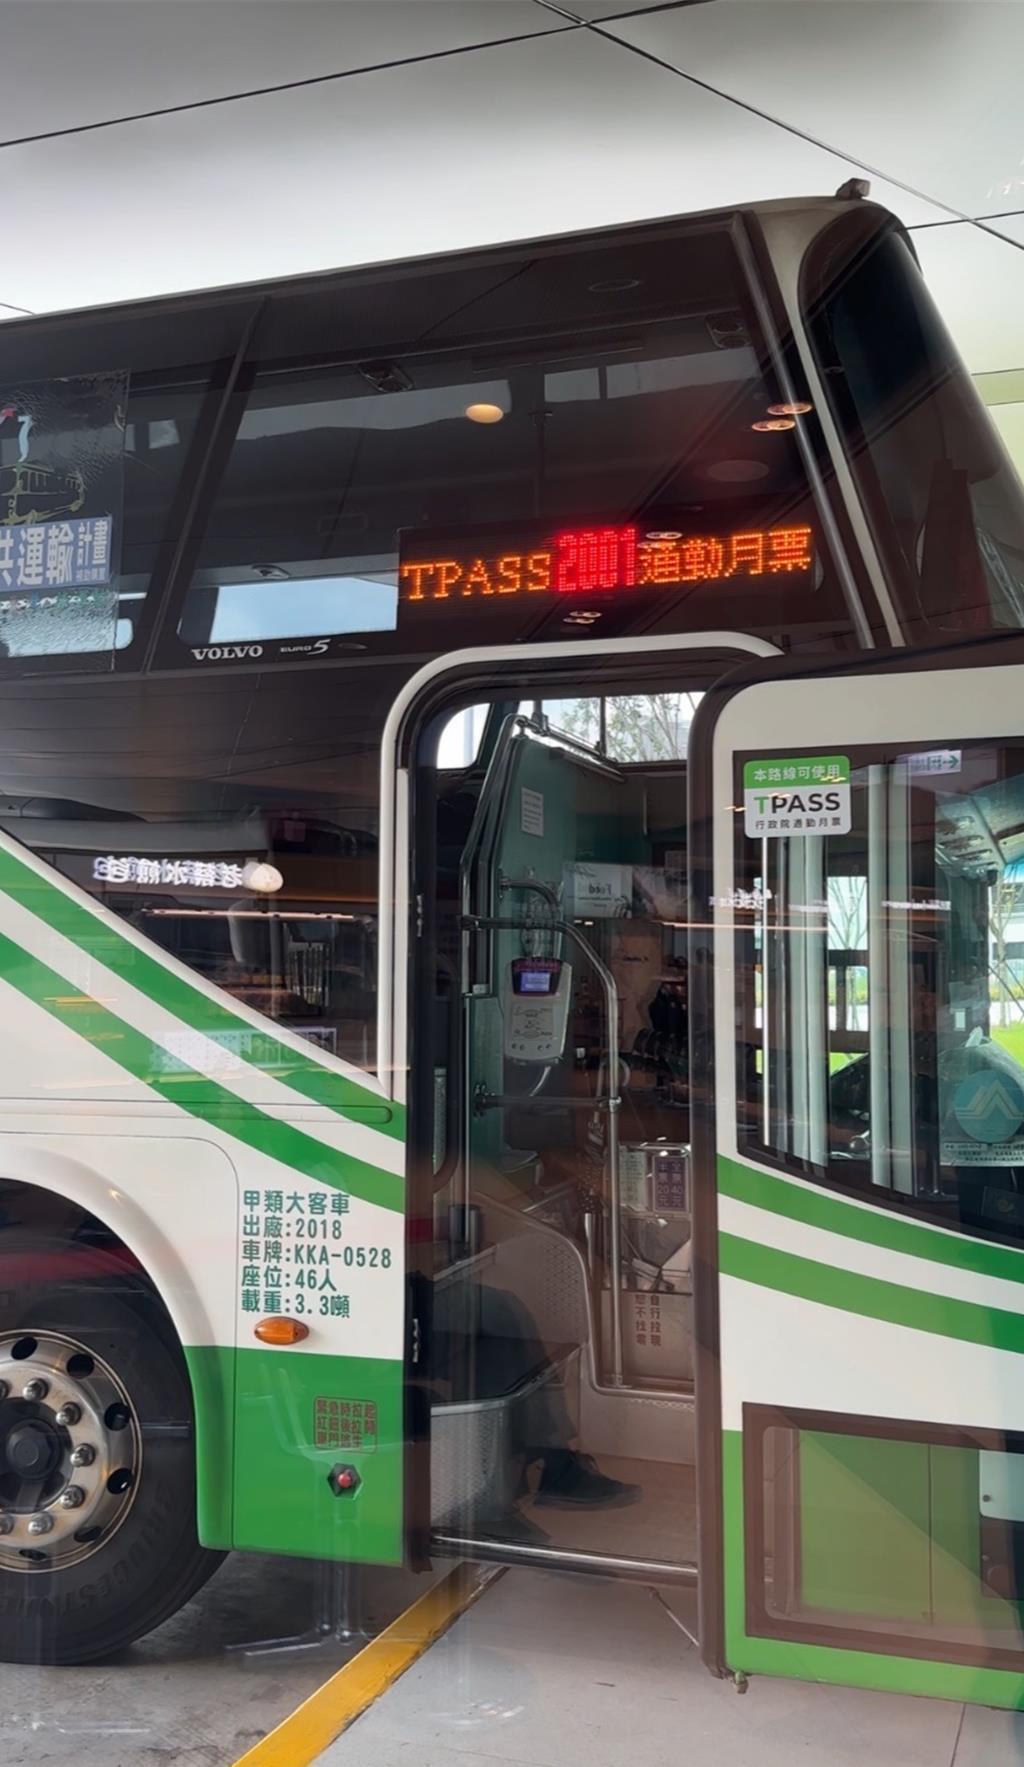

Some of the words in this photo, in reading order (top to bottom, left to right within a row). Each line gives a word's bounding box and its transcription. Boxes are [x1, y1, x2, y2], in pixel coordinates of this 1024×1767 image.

[402, 553, 551, 600] TPASS
[557, 528, 637, 592] 2001
[638, 528, 811, 585] 通勤月票
[192, 645, 263, 660] VOLVO
[753, 764, 840, 782] 本路線可使用
[753, 792, 841, 815] TPASS
[755, 817, 841, 831] 行政院通勤月票
[243, 1190, 350, 1216] 甲類大客車
